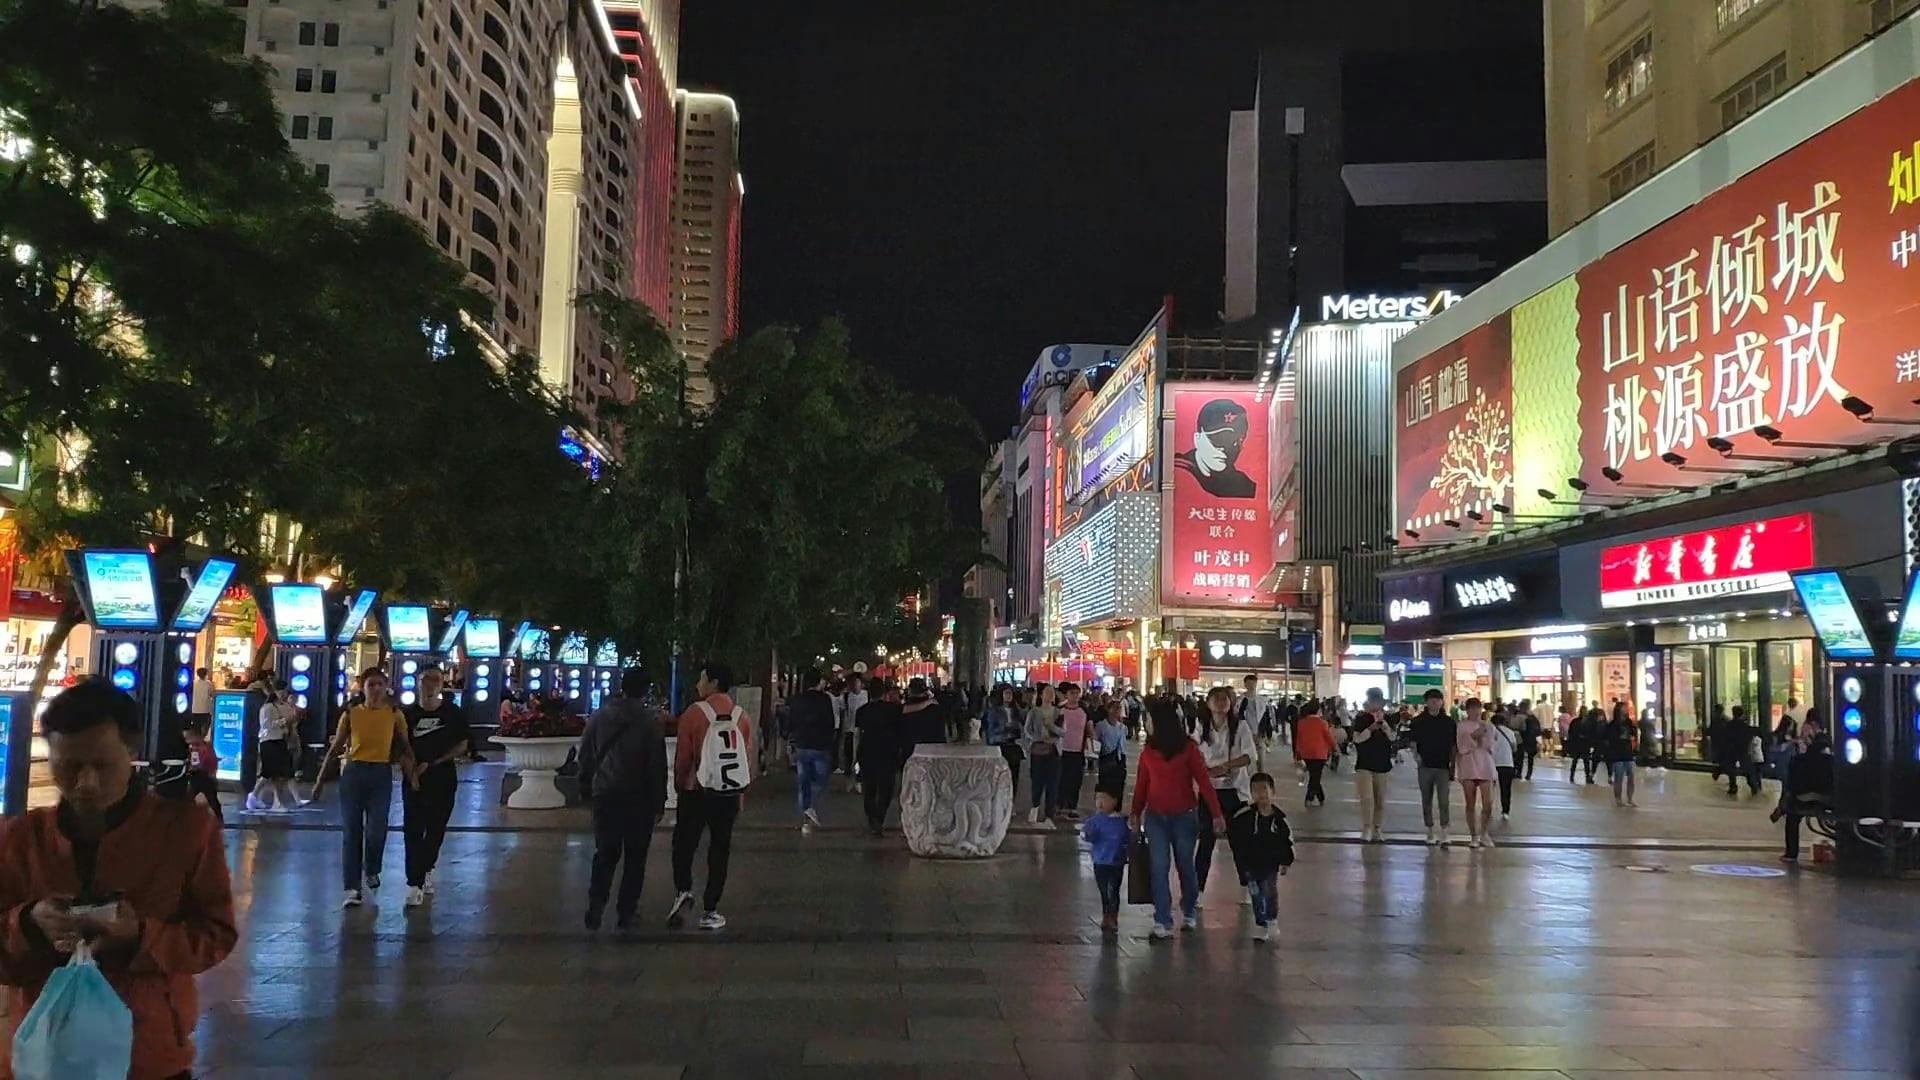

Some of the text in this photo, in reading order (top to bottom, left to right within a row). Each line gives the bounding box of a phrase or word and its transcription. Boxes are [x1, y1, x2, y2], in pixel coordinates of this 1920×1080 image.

[1602, 181, 1846, 373] 山语倾城
[1891, 228, 1920, 268] 中
[1602, 301, 1849, 469] 桃源盛放
[1896, 349, 1920, 384] 洋
